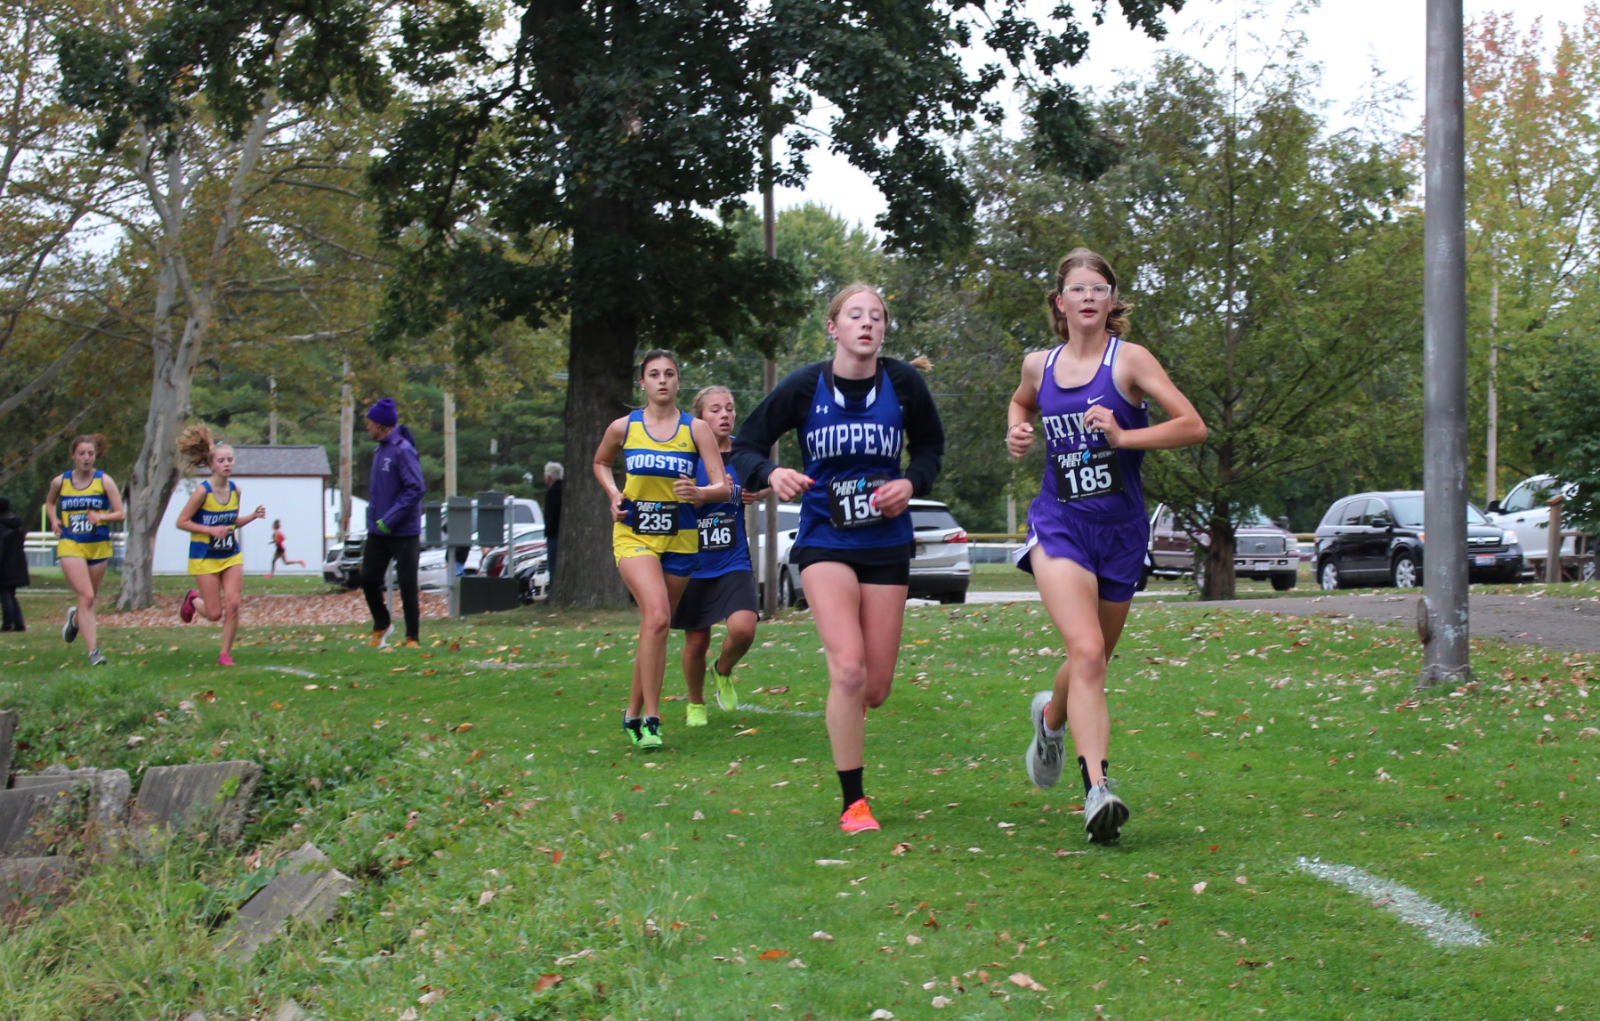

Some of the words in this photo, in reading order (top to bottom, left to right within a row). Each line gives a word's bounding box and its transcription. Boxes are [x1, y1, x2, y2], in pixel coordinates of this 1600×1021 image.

[1042, 409, 1113, 440] TRIW
[626, 454, 693, 475] WOOSTER
[1065, 464, 1112, 494] 185
[72, 520, 93, 533] 216
[202, 513, 237, 525] WOOST
[639, 513, 672, 530] 235
[214, 535, 233, 548] 214
[700, 527, 731, 546] 146
